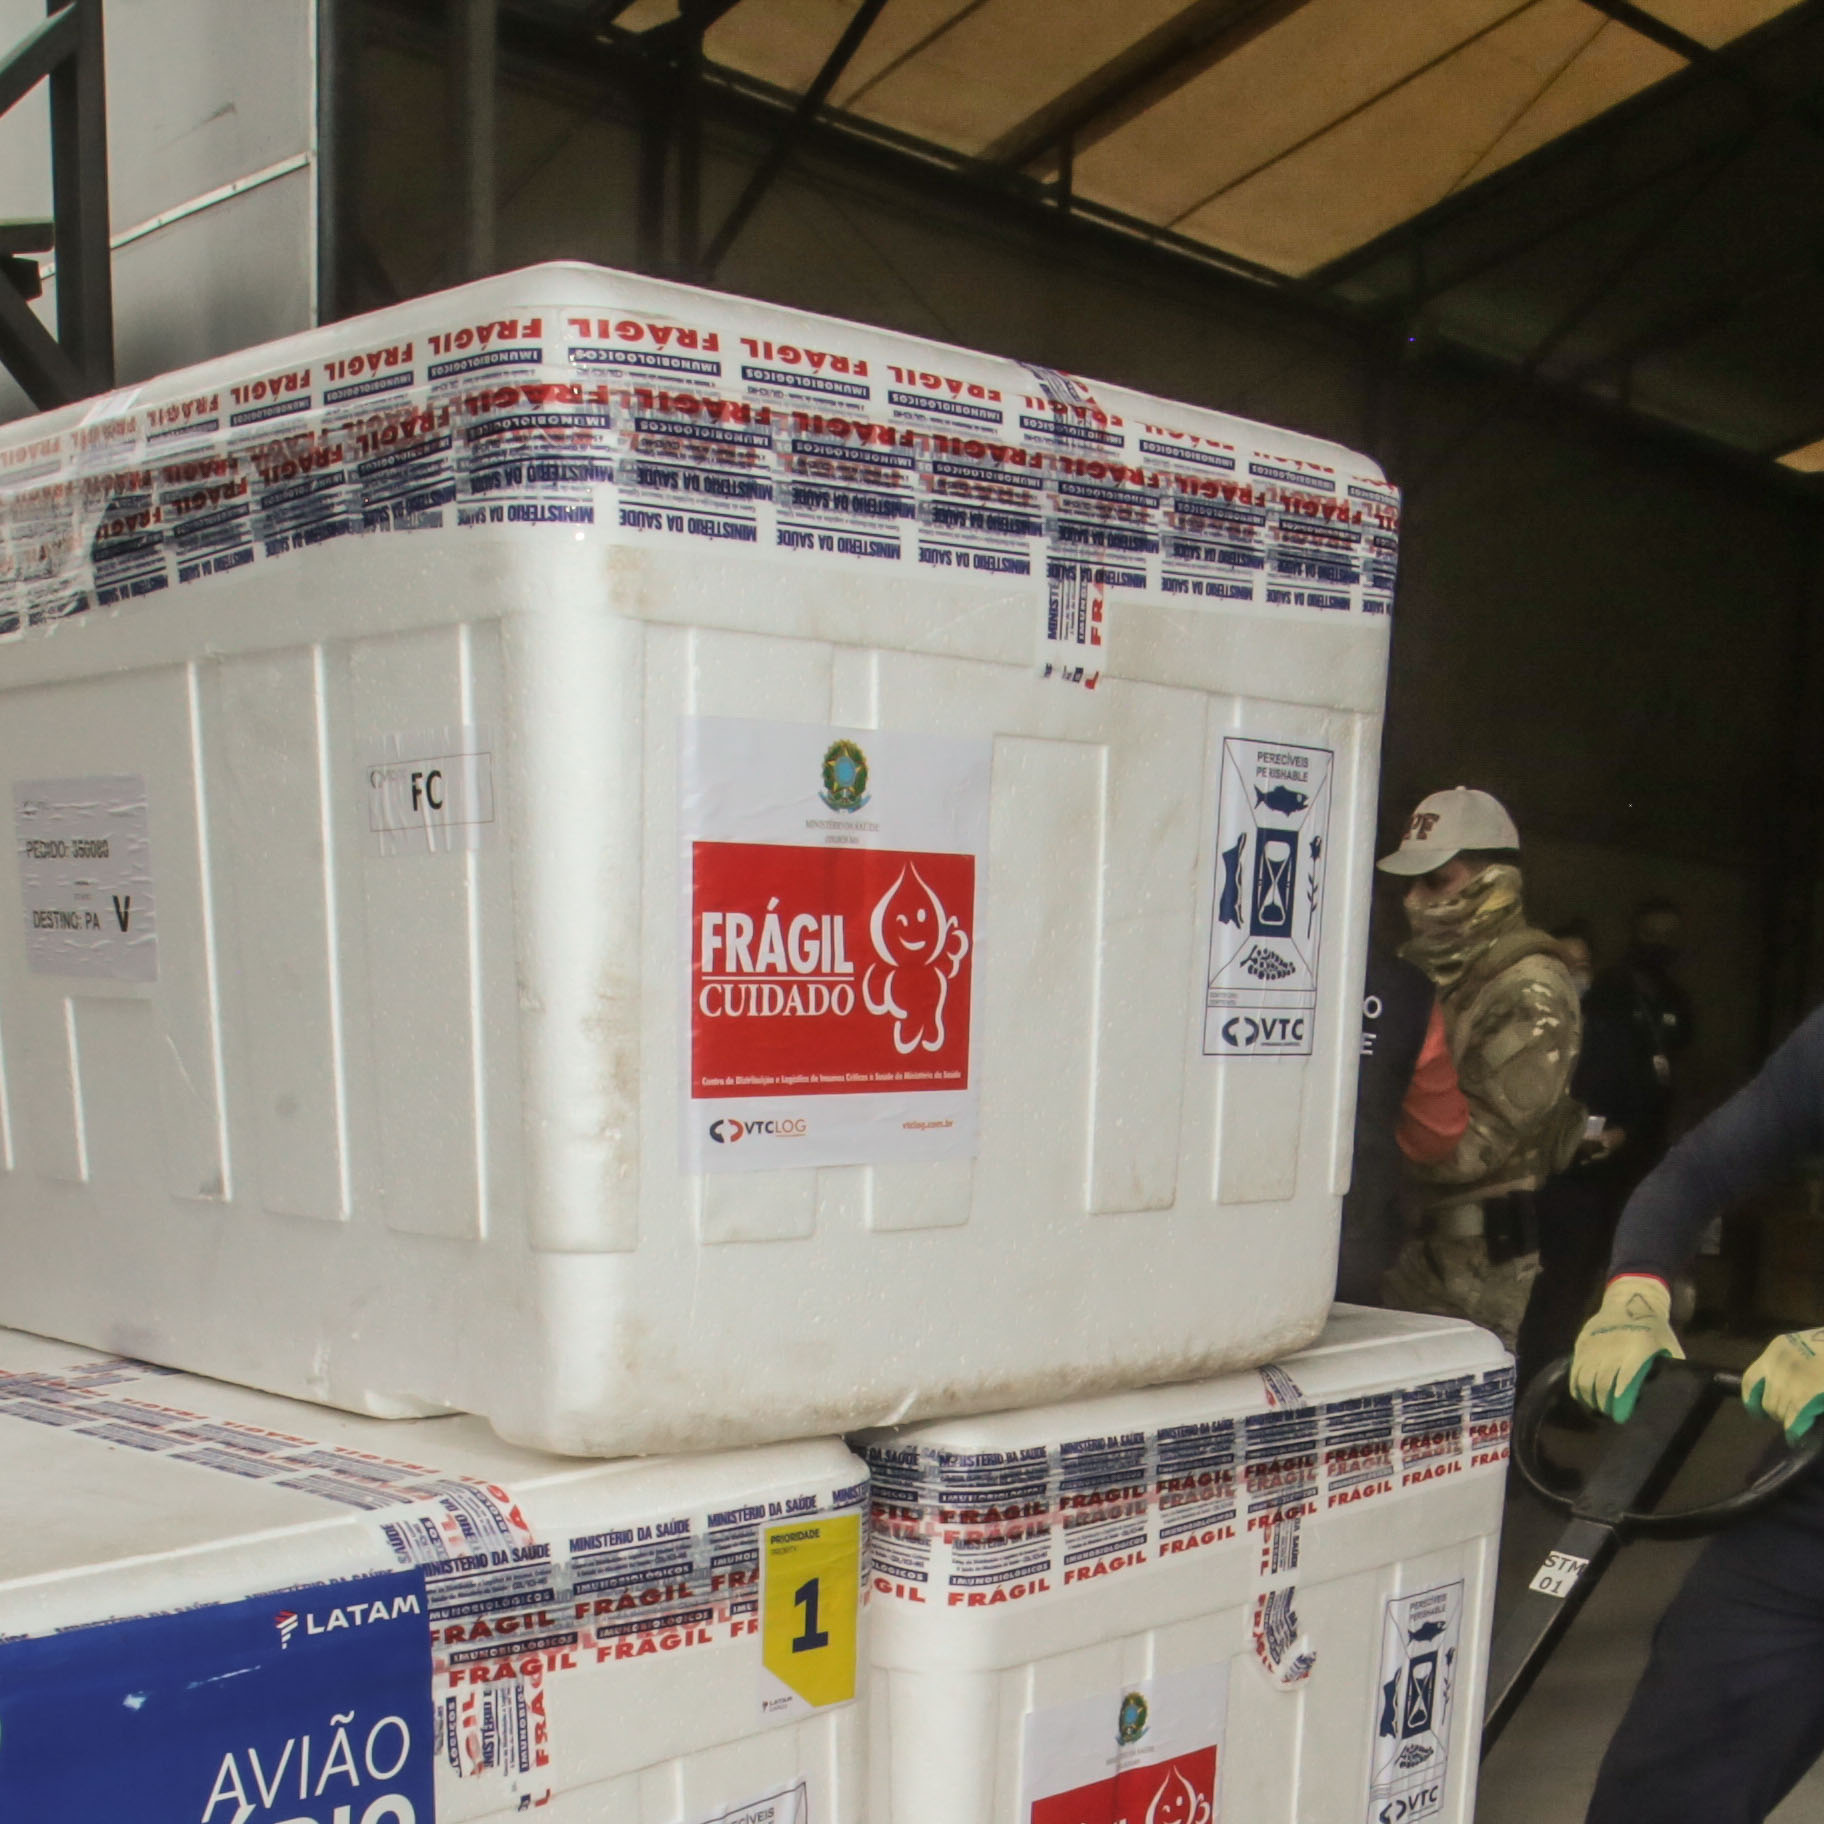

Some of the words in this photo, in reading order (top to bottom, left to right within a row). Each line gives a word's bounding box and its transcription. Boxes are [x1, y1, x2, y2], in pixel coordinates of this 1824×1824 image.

[428, 319, 542, 354] FRÁGIL
[568, 319, 719, 351] FRÁGIL
[324, 343, 413, 381] FRÁGIL
[740, 338, 868, 378] FRÁGIL
[231, 369, 311, 405] FRÁGIL
[620, 509, 662, 532] SAÚDE
[667, 514, 684, 532] DA
[688, 519, 757, 542] MINISTÉRIO
[777, 529, 814, 551] SAÚDE
[818, 535, 834, 550] DA
[838, 537, 901, 560] MINISTÉRIO
[956, 552, 969, 567] DA
[411, 769, 443, 812] FC
[85, 912, 101, 931] PA
[112, 895, 131, 933] V
[701, 897, 854, 973] FRÁGIL
[699, 984, 855, 1017] CUIDADO
[1261, 1018, 1304, 1041] VTC
[744, 1119, 807, 1134] VTCLOG
[1402, 1460, 1462, 1487] FRÁGIL
[1328, 1480, 1393, 1509] FRÁGIL
[708, 1504, 766, 1528] MINISTÉRIO
[769, 1500, 782, 1516] DA
[786, 1494, 816, 1512] SAÚDE
[570, 1529, 633, 1552] MINISTÉRIO
[638, 1526, 652, 1541] DA
[656, 1518, 690, 1537] SAÚDE
[770, 1528, 820, 1545] PRIORIDADE
[1159, 1526, 1236, 1558] FRÁGIL
[492, 1551, 509, 1566] DA
[513, 1543, 550, 1562] SAÚDE
[1065, 1551, 1147, 1585] FRÁGIL
[576, 1582, 693, 1620] FRÁGIL
[948, 1577, 1051, 1607] FRÁGIL
[307, 1594, 421, 1637] LATAM
[792, 1577, 829, 1654] 1
[597, 1626, 712, 1663] FRÁGIL
[449, 1652, 576, 1688] FRÁGIL
[202, 1711, 411, 1824] AVIÃO
[1409, 1785, 1439, 1811] VTC
